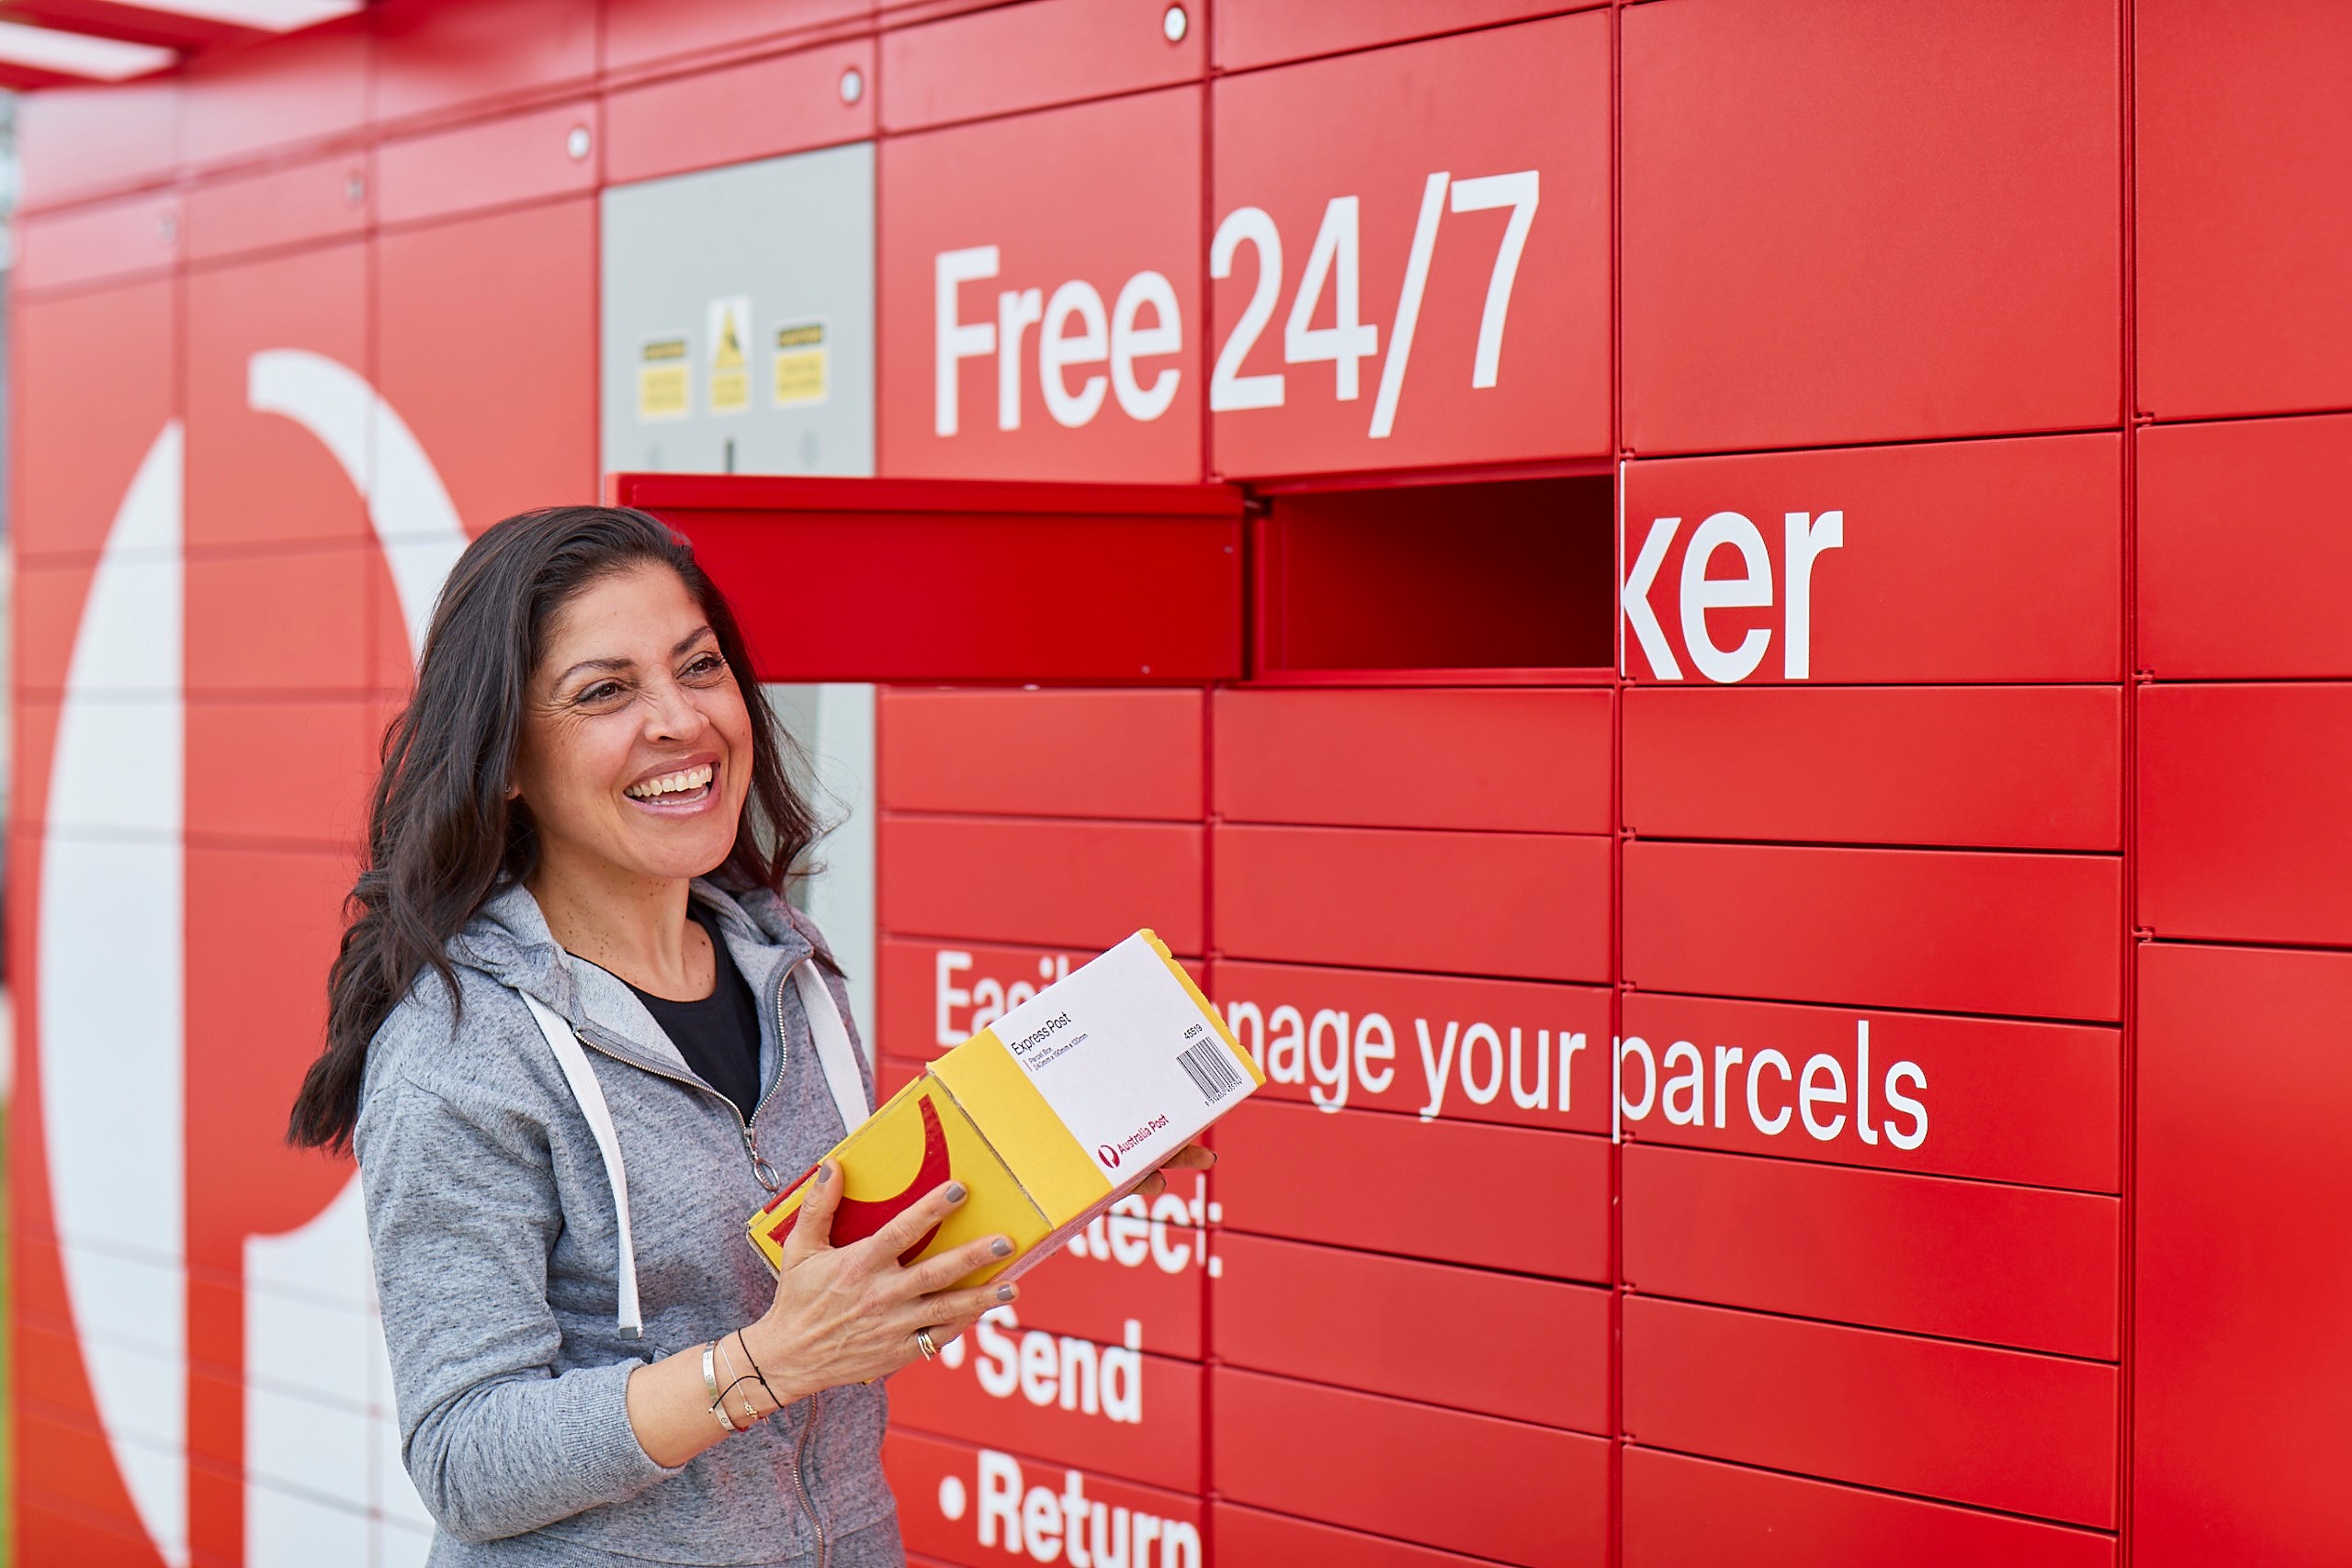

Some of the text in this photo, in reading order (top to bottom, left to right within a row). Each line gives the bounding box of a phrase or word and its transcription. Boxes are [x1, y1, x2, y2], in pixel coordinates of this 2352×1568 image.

[933, 170, 1540, 438] Free 24/7
[1011, 1011, 1072, 1055] Express Post
[1183, 1023, 1203, 1040] 45519
[1212, 1000, 1928, 1150] nage your parcels
[1116, 1113, 1170, 1155] Australia Post
[975, 1304, 1142, 1424] Send
[978, 1449, 1202, 1568] Return
